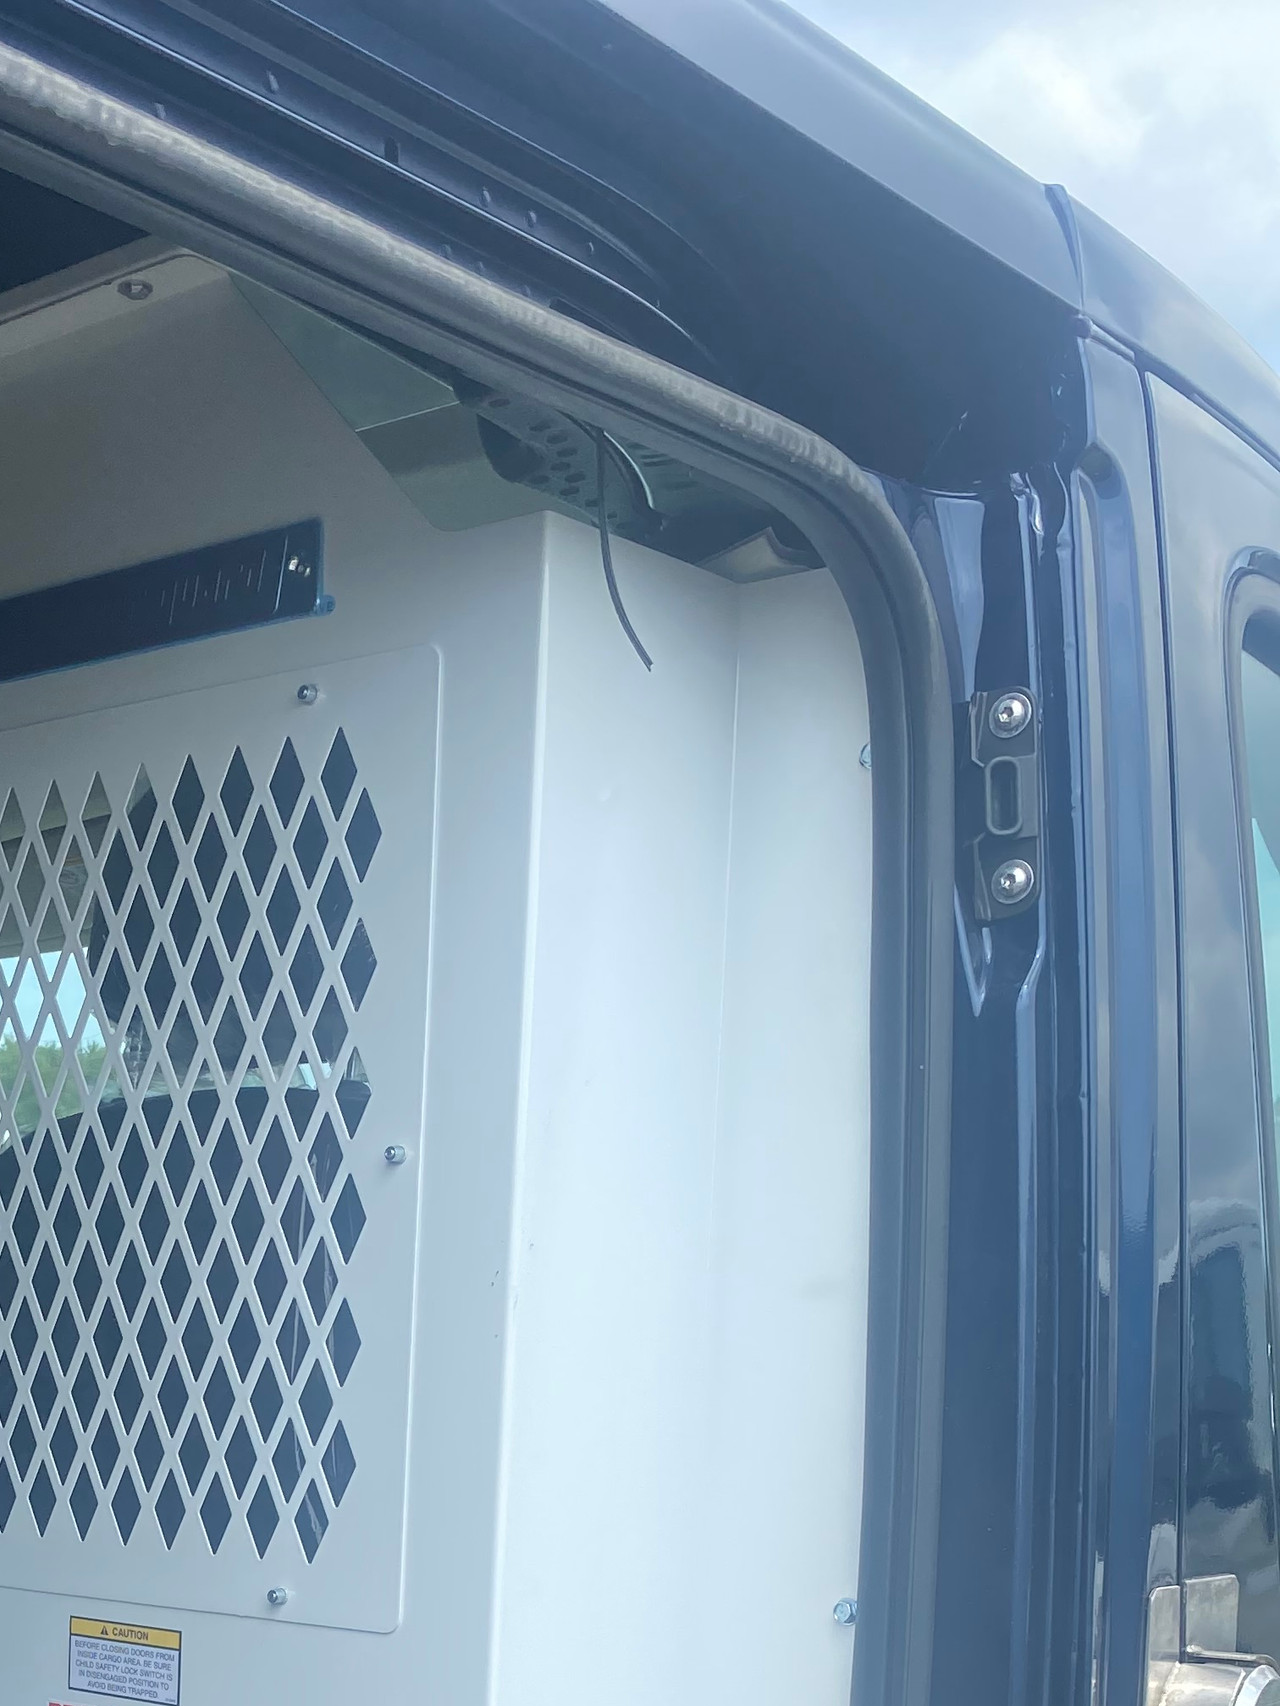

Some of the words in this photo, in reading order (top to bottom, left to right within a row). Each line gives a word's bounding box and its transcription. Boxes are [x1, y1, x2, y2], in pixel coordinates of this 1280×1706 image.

[111, 1627, 149, 1641] CAUTION
[74, 1640, 100, 1650] BEFORE
[100, 1643, 130, 1655] CLOSING
[130, 1648, 154, 1659] DOORS
[155, 1652, 175, 1662] FROM
[77, 1650, 97, 1660] INSIDE
[98, 1653, 122, 1663] CARGO
[143, 1660, 152, 1668] BE
[153, 1661, 172, 1671] SURE
[75, 1659, 94, 1668] CHILD
[95, 1662, 120, 1673] SAFETY
[120, 1666, 138, 1676] LOCK
[139, 1669, 165, 1680] SWITCH
[166, 1673, 173, 1681] IS
[78, 1669, 85, 1677] IN
[86, 1670, 127, 1684] DISENGAGED
[128, 1677, 159, 1689] POSITION
[160, 1682, 169, 1691] TO
[87, 1680, 106, 1690] AVOID
[107, 1683, 127, 1694] BEING
